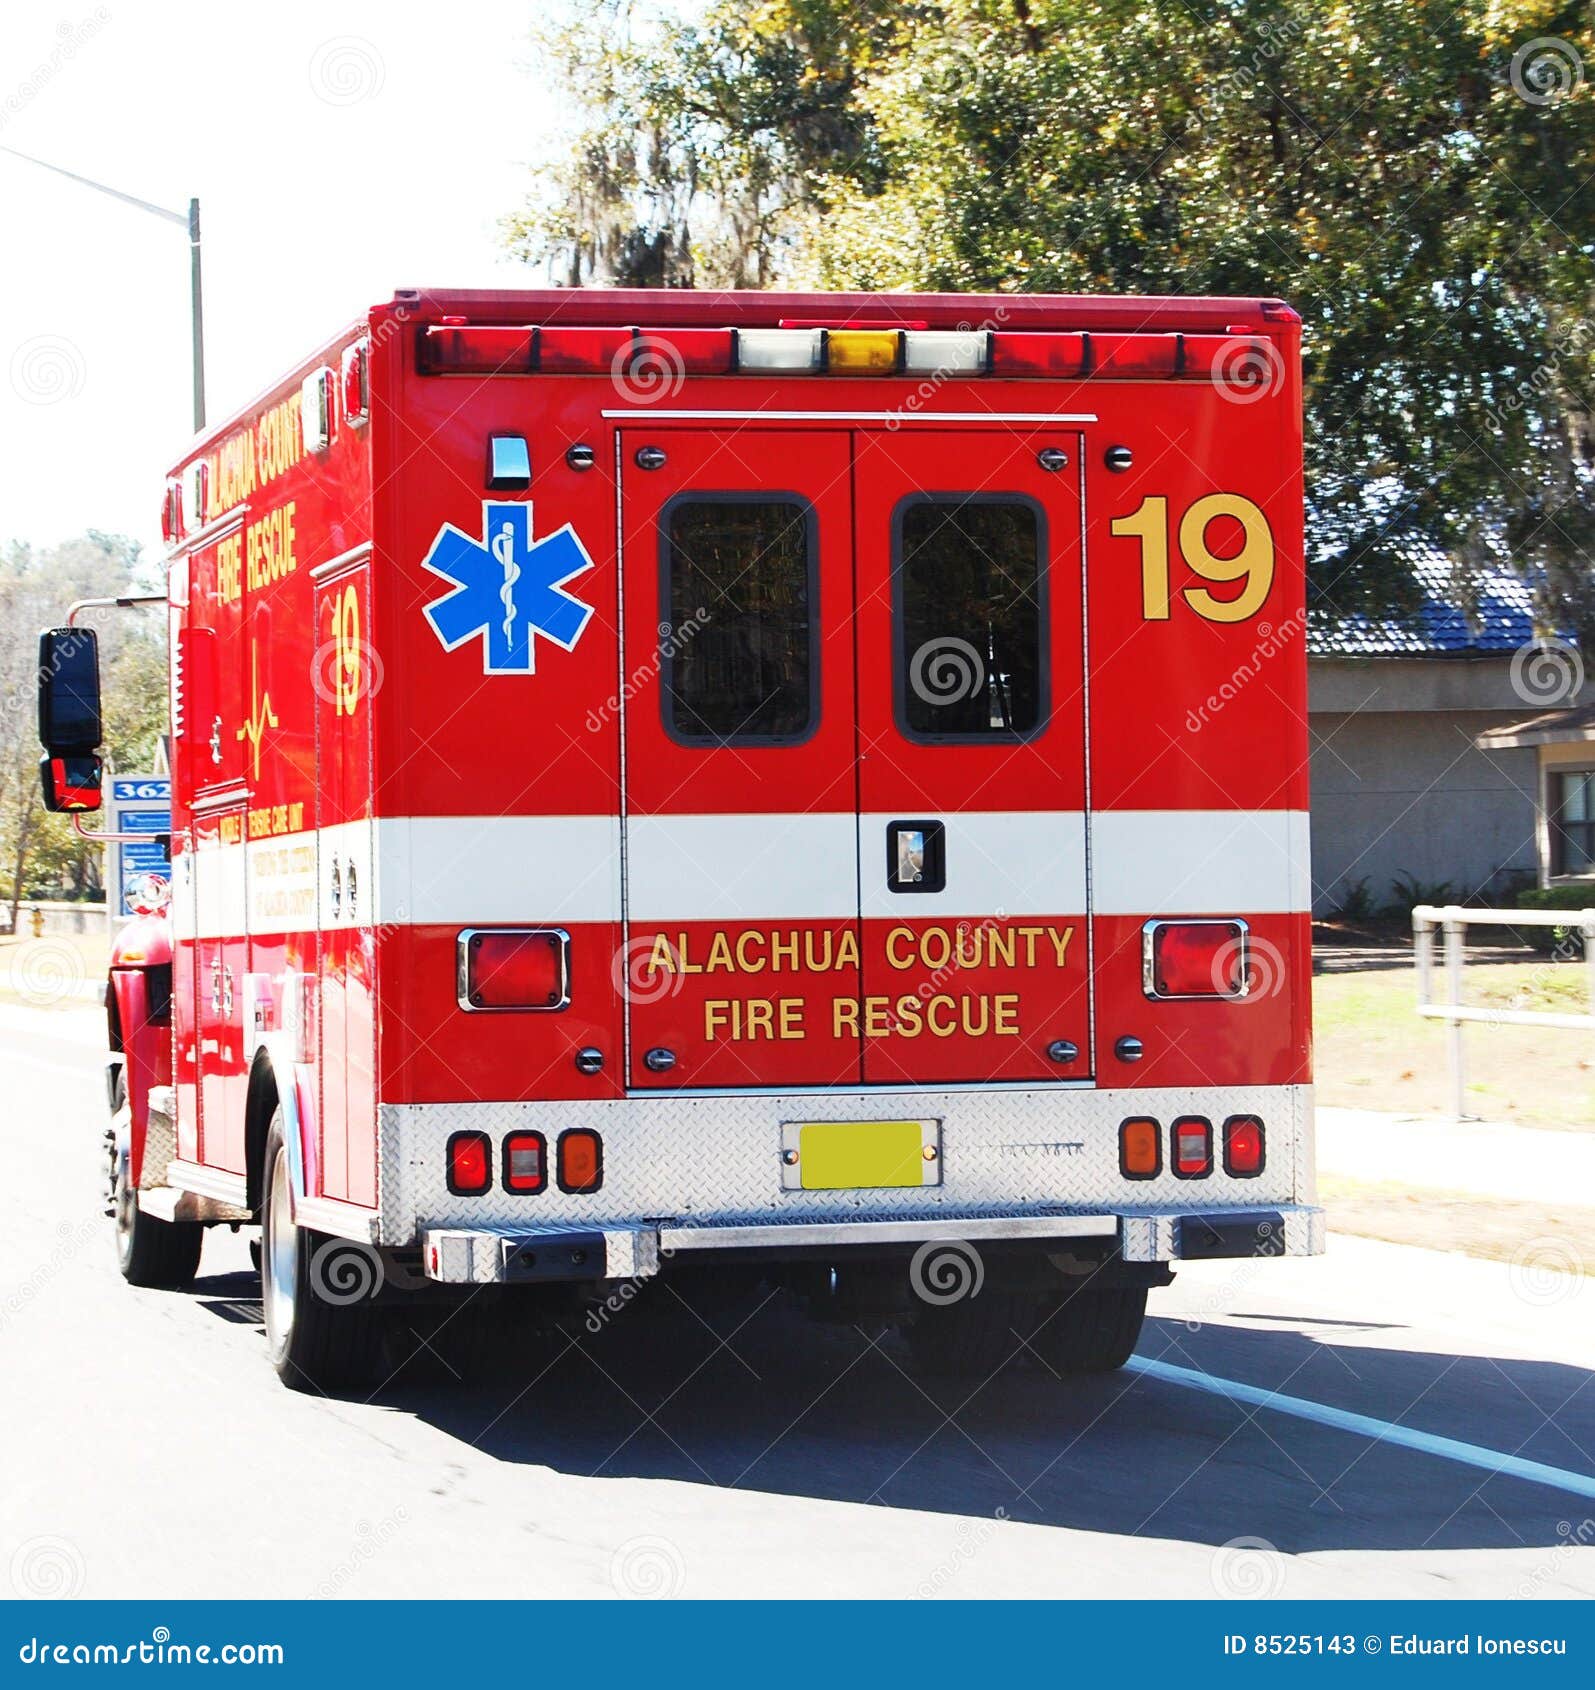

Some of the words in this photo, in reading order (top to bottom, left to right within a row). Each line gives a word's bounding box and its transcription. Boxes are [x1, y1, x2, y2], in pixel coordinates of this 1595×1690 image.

[259, 390, 308, 487] COUNT
[217, 533, 242, 607] FIRE
[247, 501, 296, 592] RESCUE
[1111, 492, 1276, 624] 19
[331, 585, 360, 716] 19
[647, 929, 861, 975] ALACHUA
[885, 926, 1074, 969] COUNTY
[704, 998, 805, 1041] FIRE
[833, 994, 1020, 1038] RESCUE
